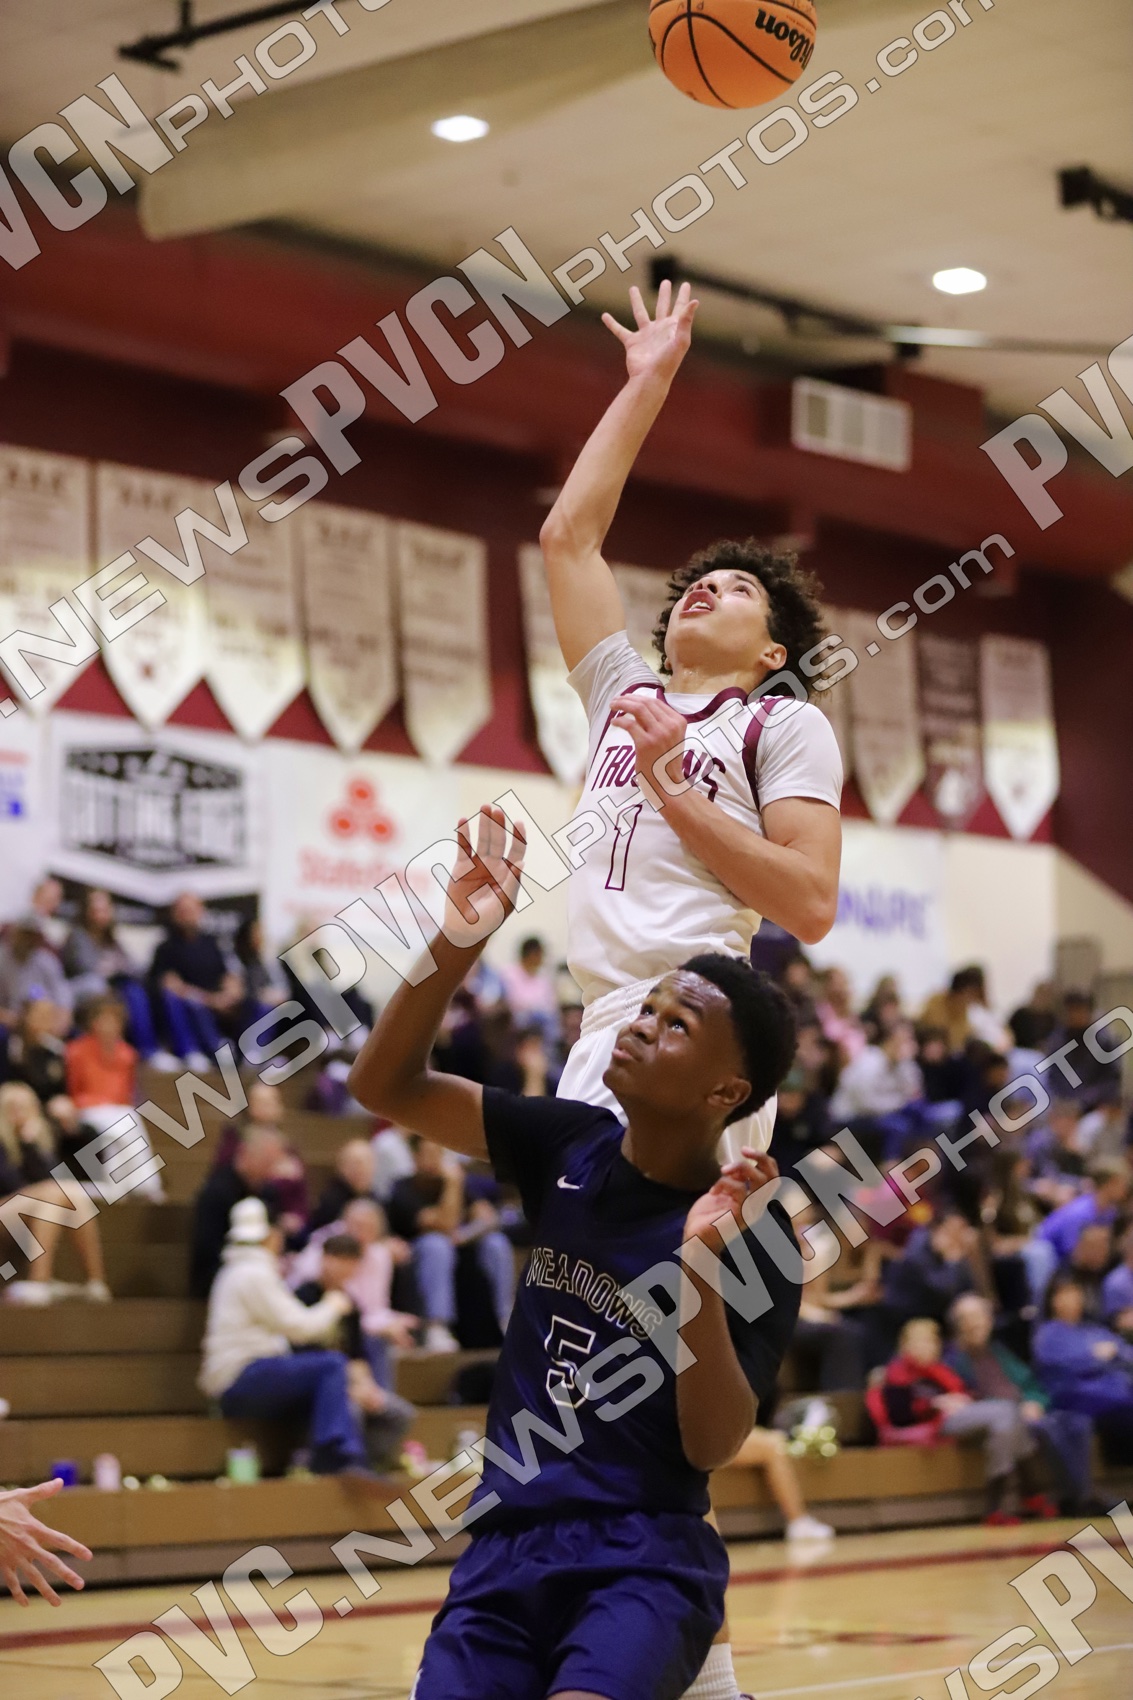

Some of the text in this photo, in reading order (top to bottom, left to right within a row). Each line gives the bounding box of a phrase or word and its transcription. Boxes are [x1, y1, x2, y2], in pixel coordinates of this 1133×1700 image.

[591, 745, 726, 803] TRONS
[605, 804, 643, 892] 1
[526, 1247, 664, 1341] MEADOWS
[544, 1314, 597, 1410] 5
